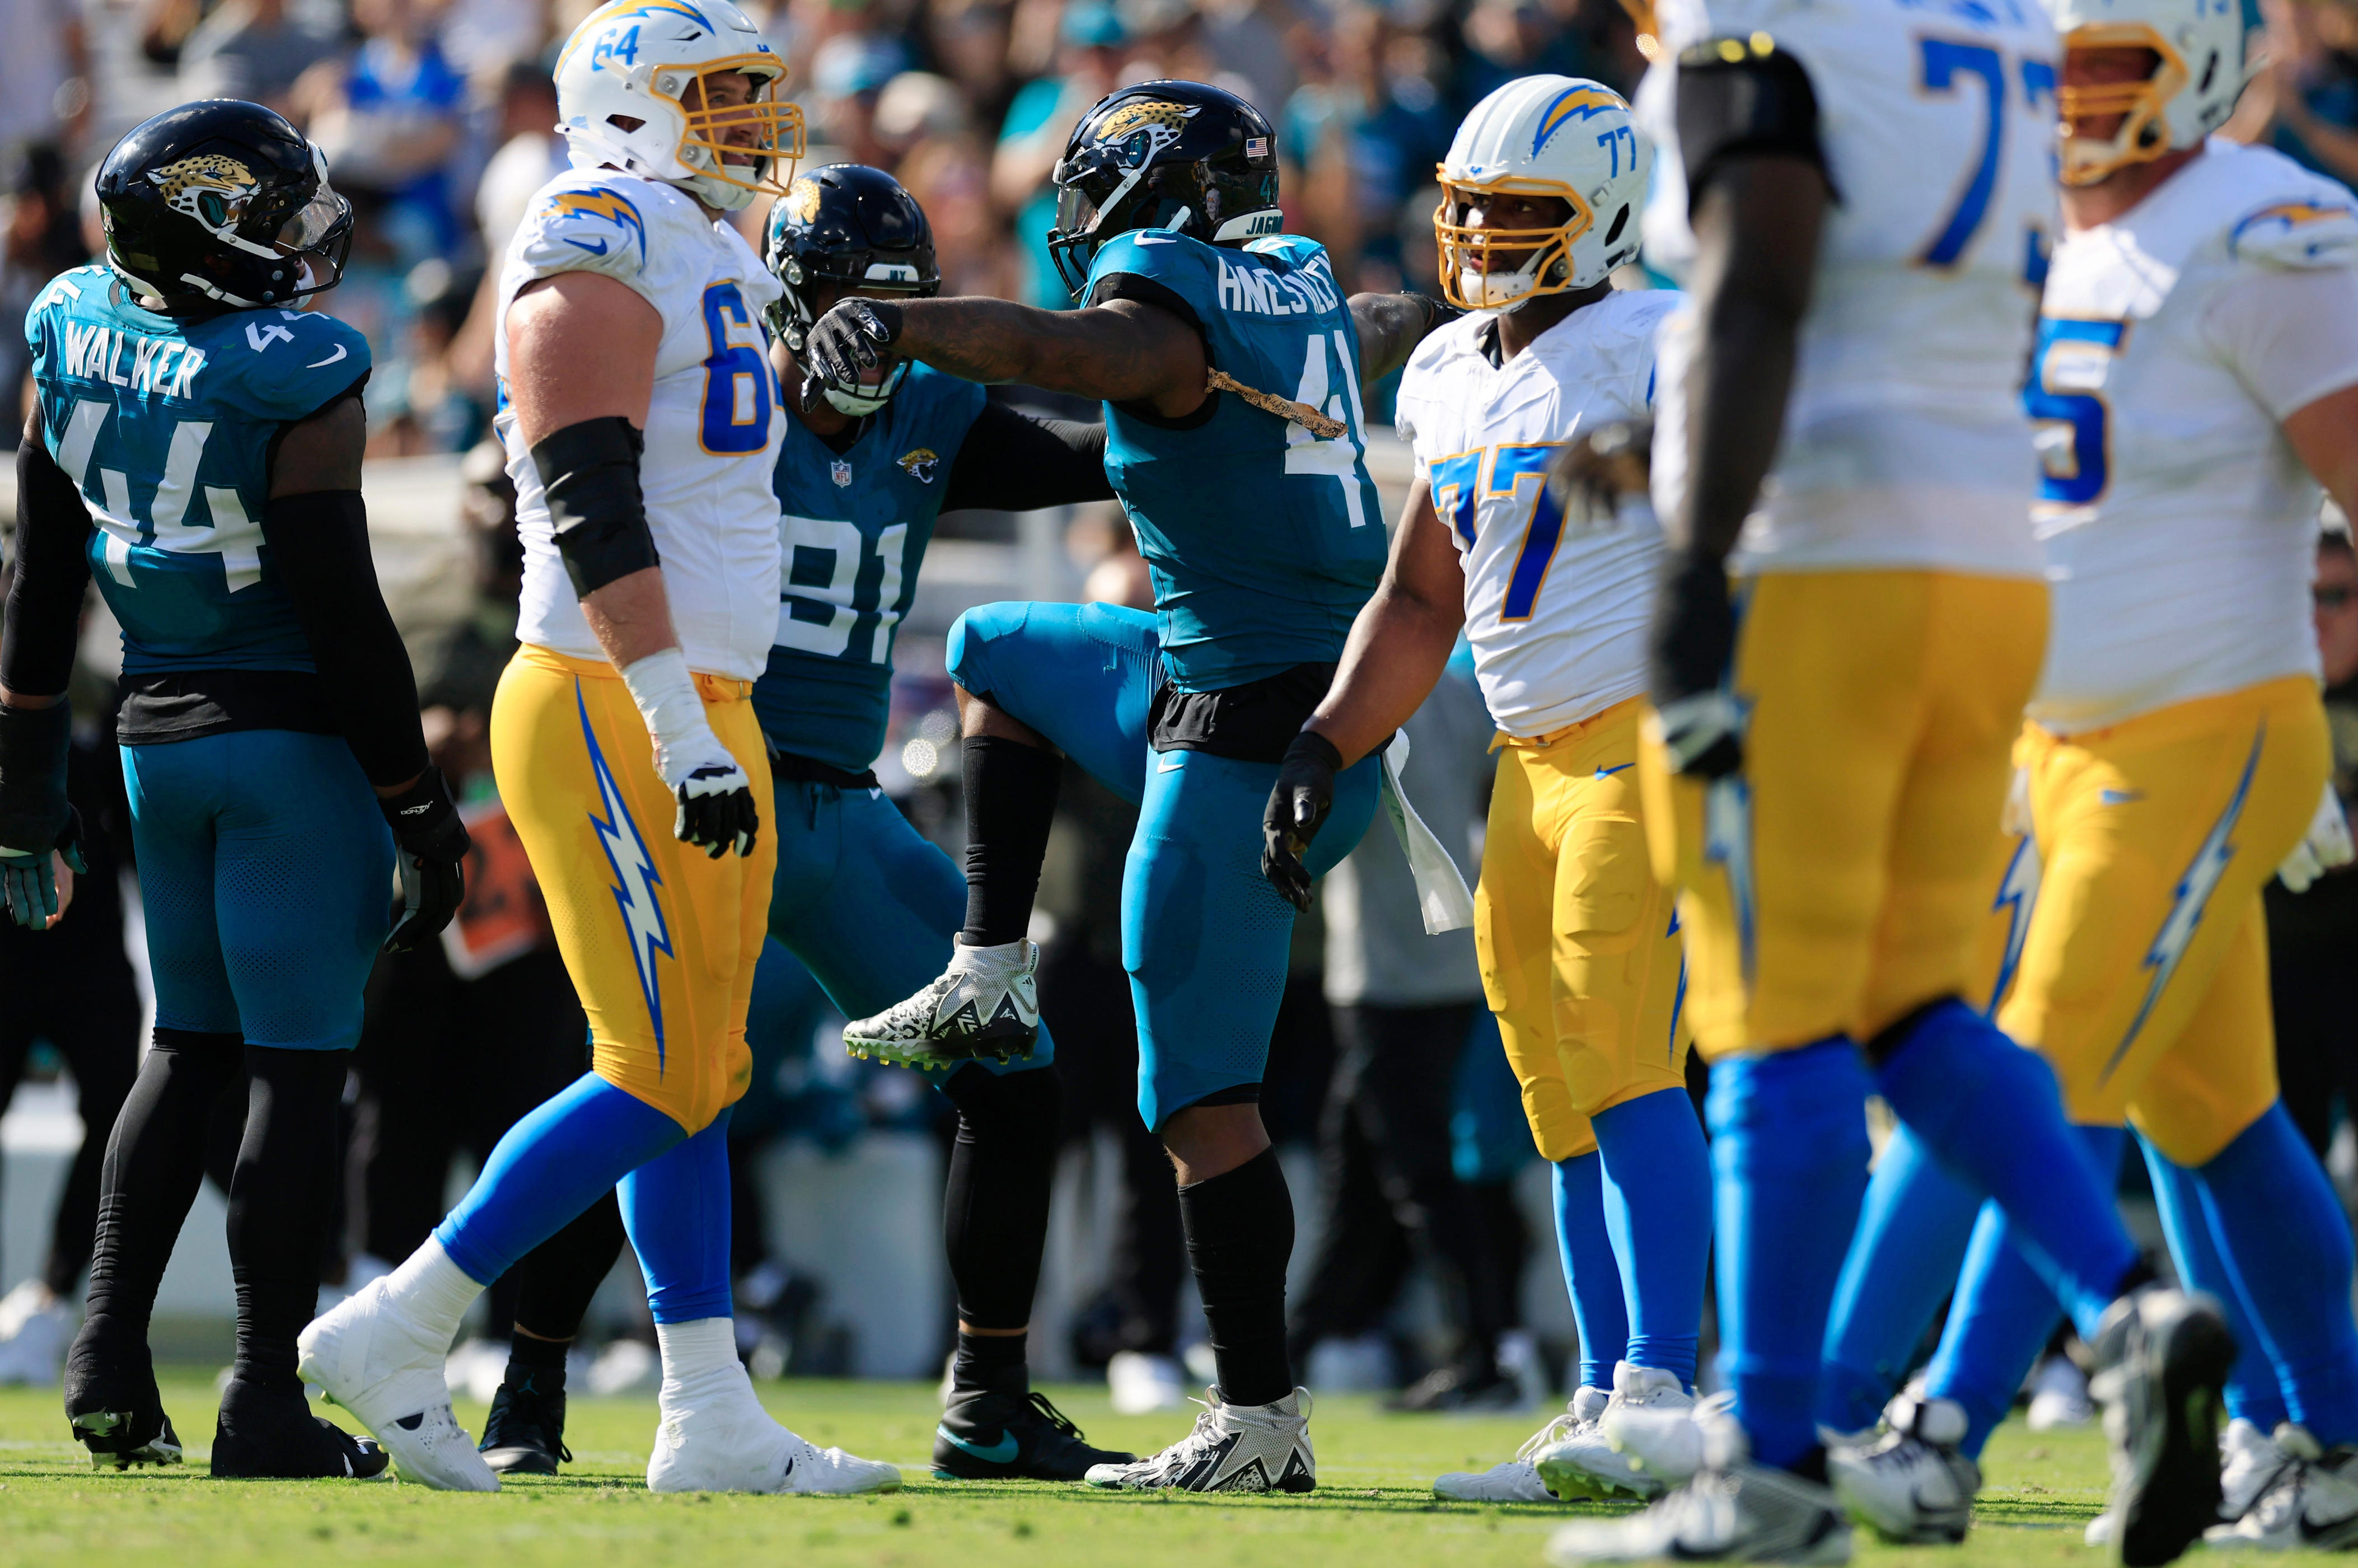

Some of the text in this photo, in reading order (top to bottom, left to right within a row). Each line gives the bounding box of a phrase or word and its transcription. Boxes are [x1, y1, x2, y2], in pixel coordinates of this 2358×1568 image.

[592, 25, 641, 72] 64
[1597, 125, 1636, 179] 77
[65, 321, 206, 400] WALKER
[698, 278, 785, 457] 6
[835, 472, 849, 483] NFL
[1284, 330, 1387, 528] 41
[57, 399, 266, 594] 44
[1428, 441, 1570, 624] 77
[776, 514, 908, 665] 91
[400, 802, 431, 815] DONJOY
